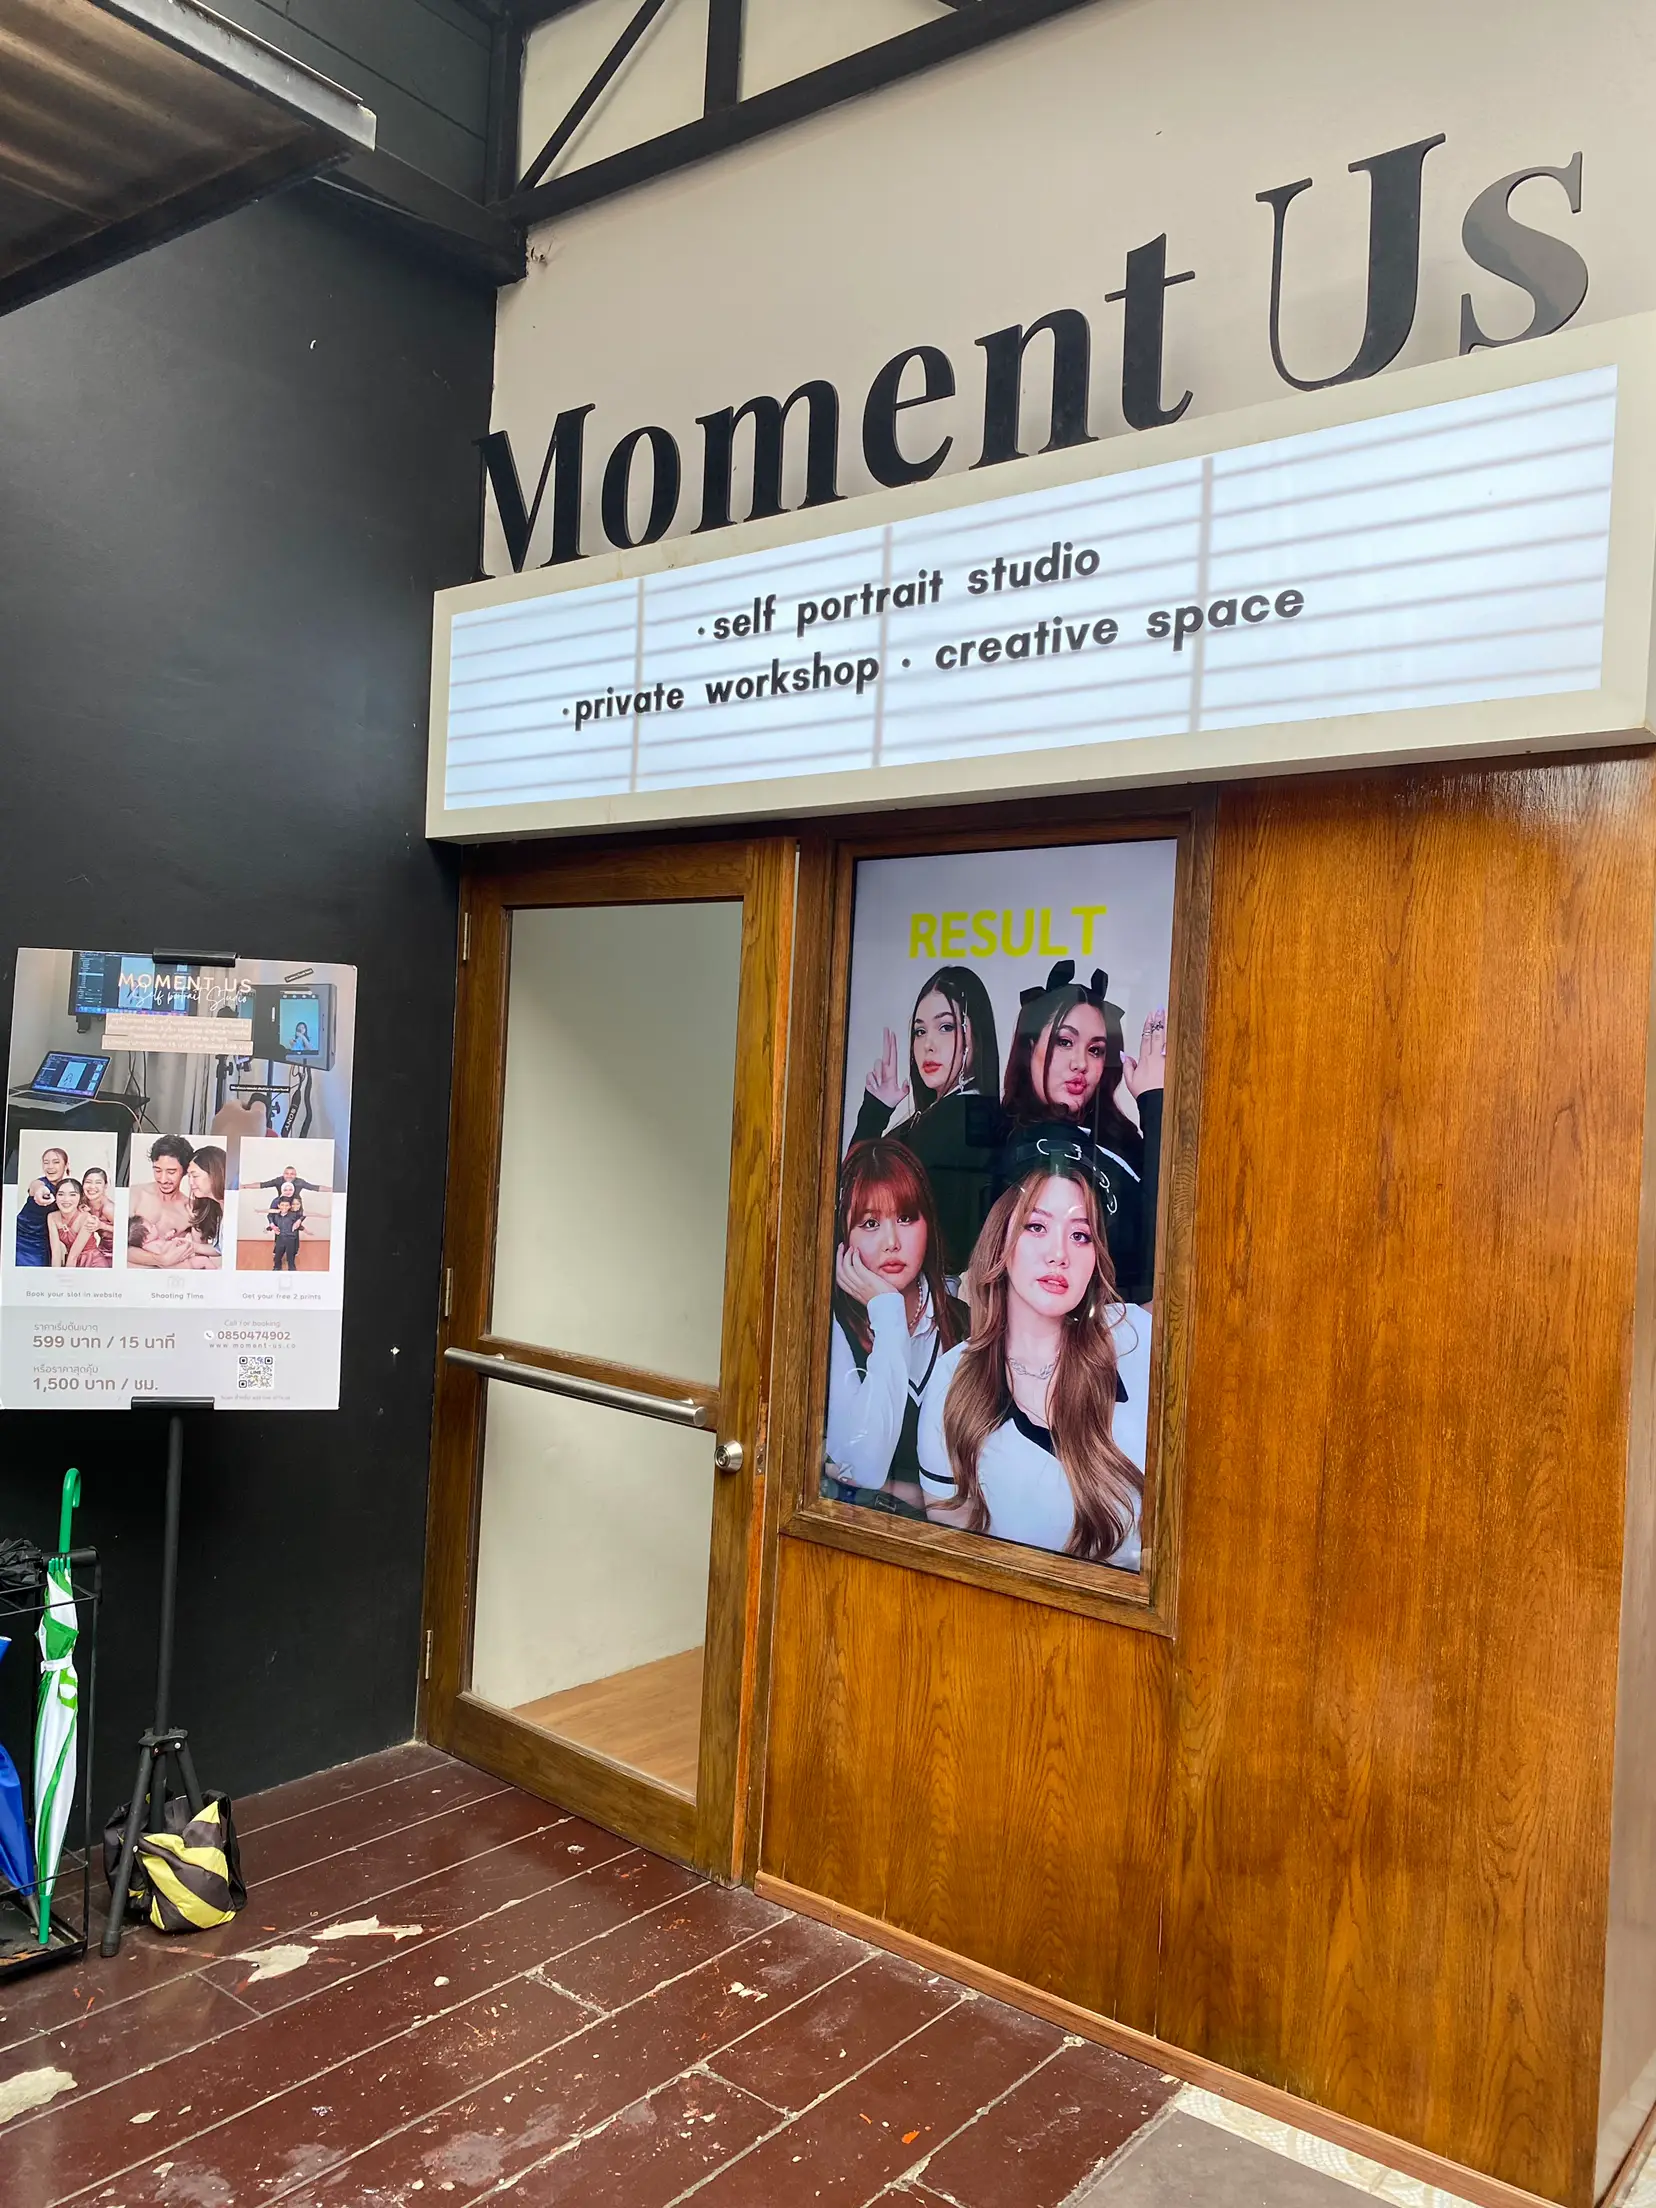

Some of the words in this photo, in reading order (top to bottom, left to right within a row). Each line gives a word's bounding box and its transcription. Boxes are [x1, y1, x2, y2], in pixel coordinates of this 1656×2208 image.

[476, 232, 1196, 580] Moment
[1256, 132, 1590, 387] Us
[797, 569, 944, 637] portrait
[967, 541, 1101, 595] studio
[706, 652, 879, 695] workshop
[935, 616, 1118, 671] creative
[1146, 589, 1305, 652] space
[907, 906, 1107, 960] RESULT
[118, 972, 214, 992] MOMENT
[224, 978, 252, 994] US
[26, 1290, 45, 1298] Book
[47, 1291, 64, 1300] your
[151, 1292, 184, 1300] Shooting
[257, 1293, 273, 1301] your
[300, 1293, 322, 1301] prints
[252, 1320, 281, 1328] booking
[33, 1335, 65, 1348] 599
[70, 1336, 101, 1349] บาท
[106, 1336, 115, 1349] /
[119, 1336, 140, 1349] 15
[144, 1333, 176, 1349] นาที
[217, 1331, 291, 1340] 0850474902
[33, 1377, 80, 1393] 1,500
[84, 1378, 116, 1391] บาท
[121, 1378, 129, 1391] /
[134, 1379, 159, 1391] ชม.
